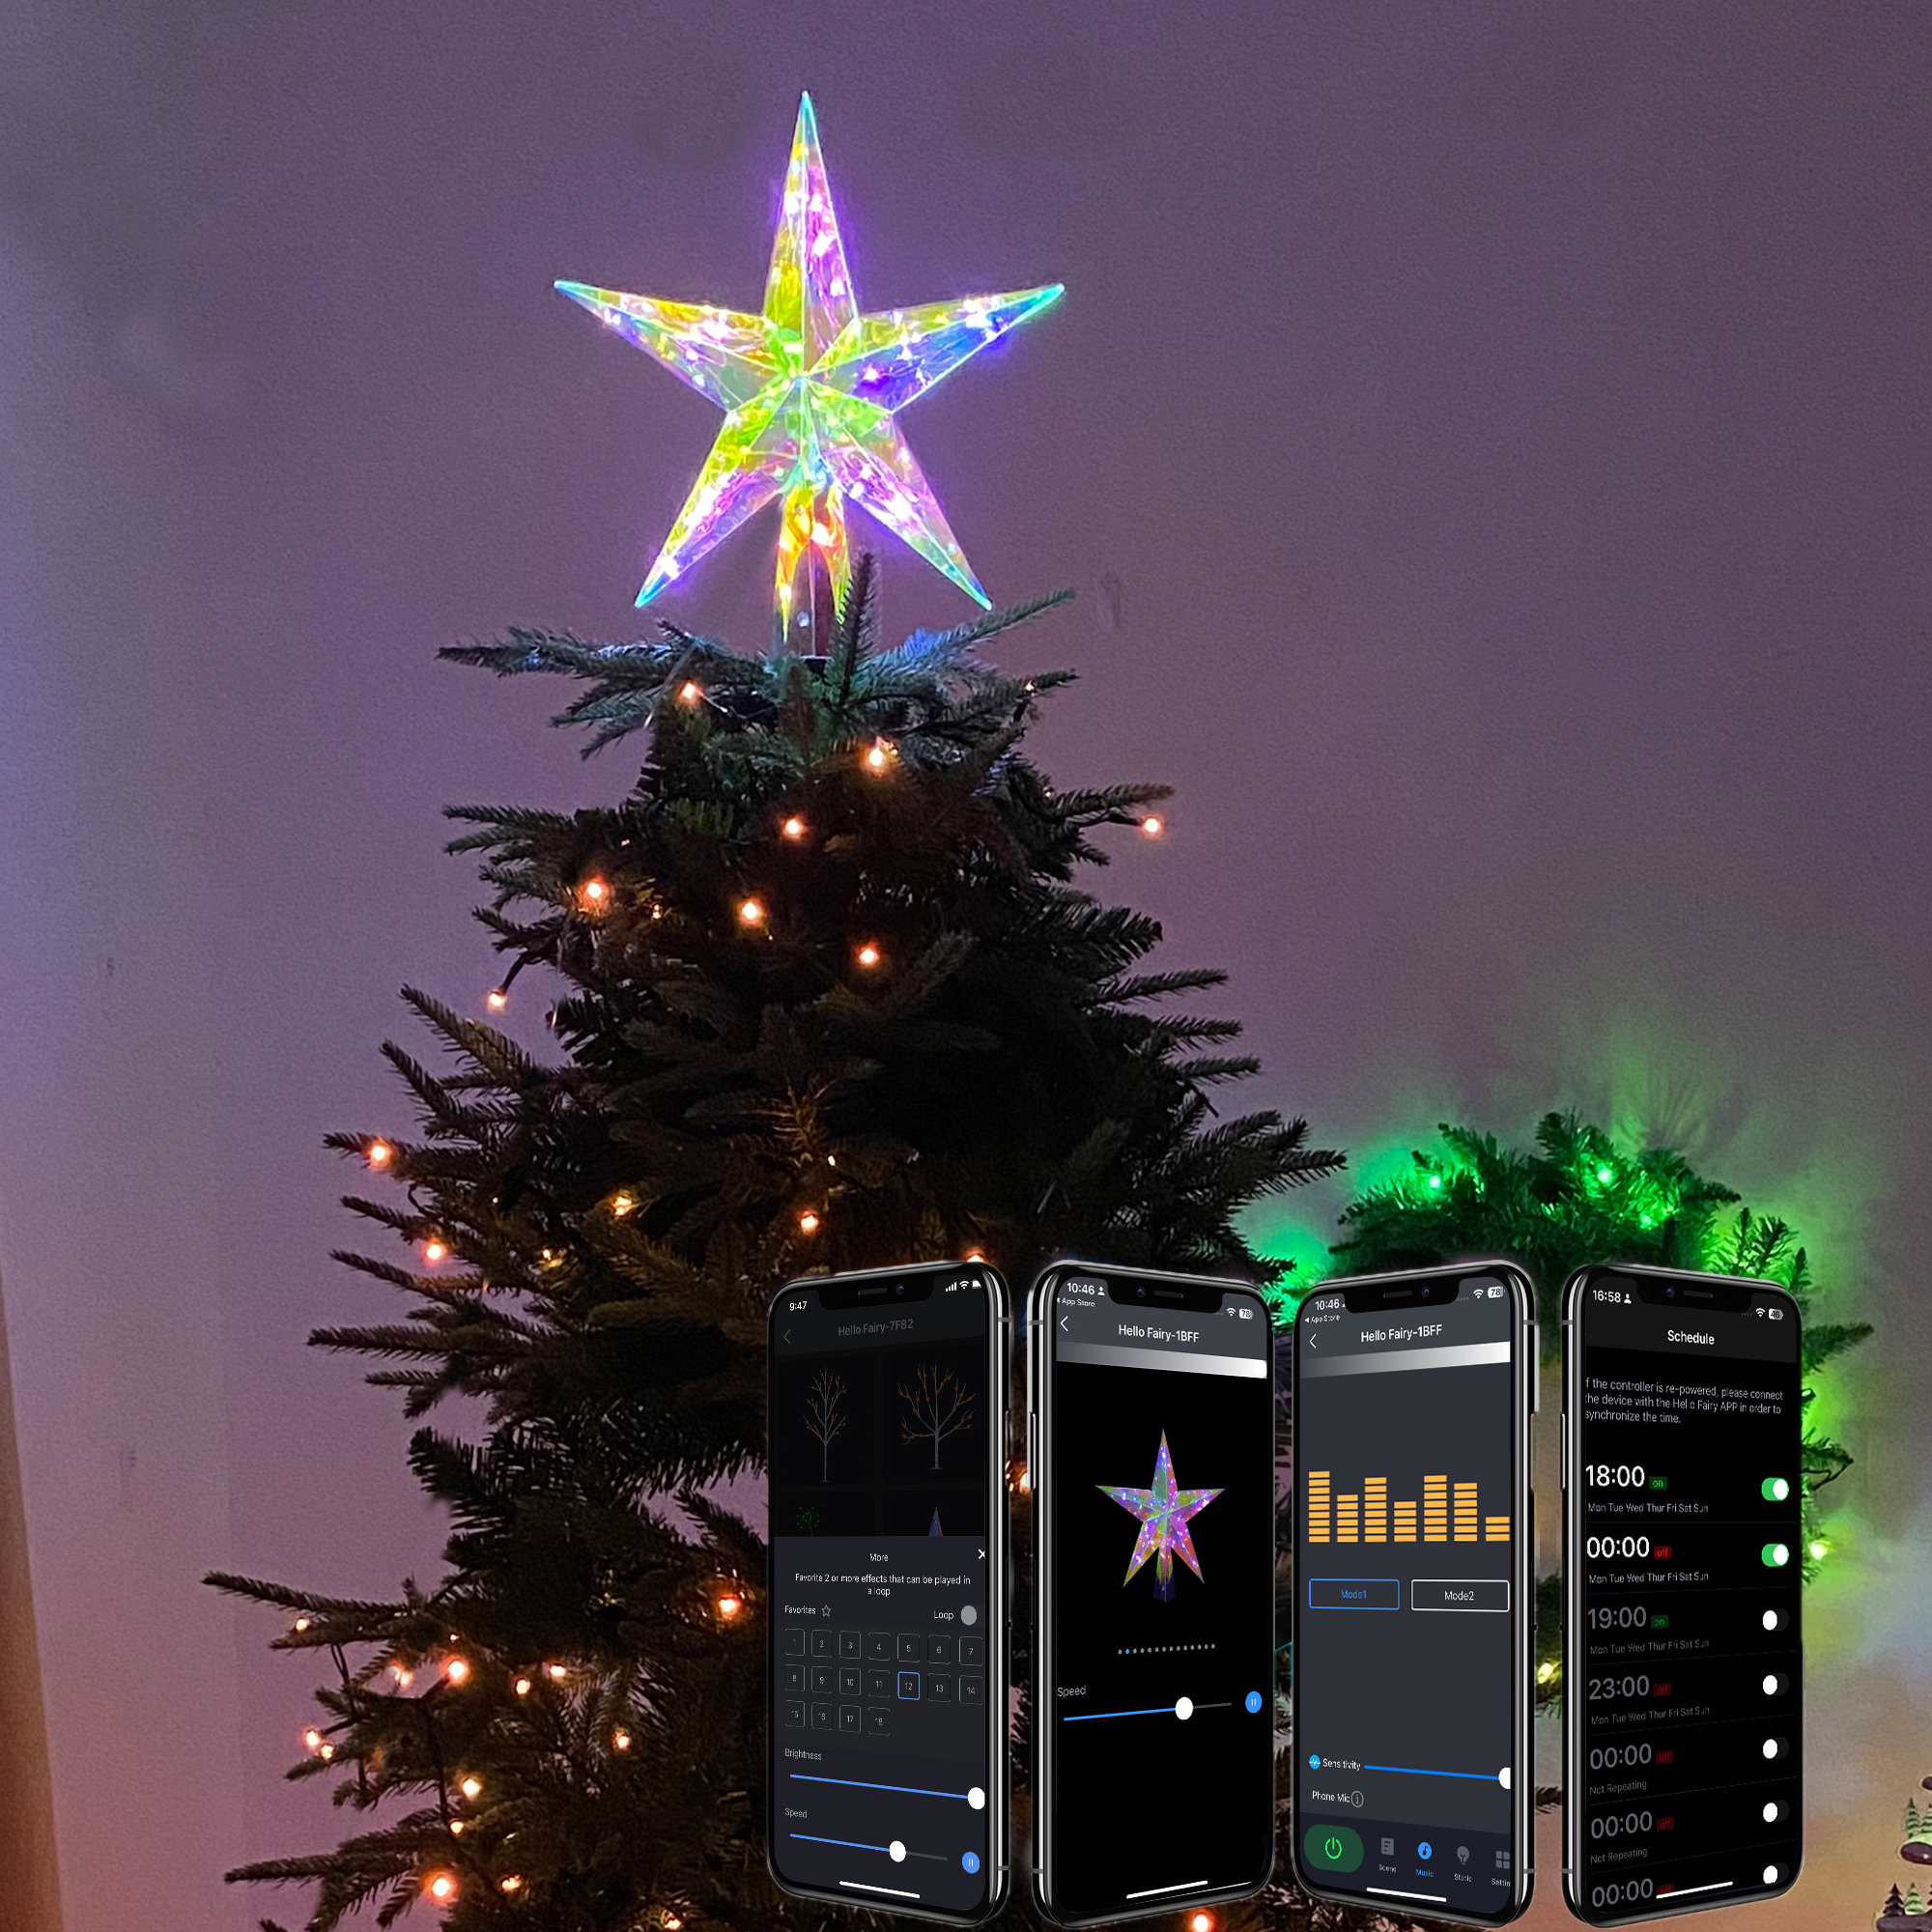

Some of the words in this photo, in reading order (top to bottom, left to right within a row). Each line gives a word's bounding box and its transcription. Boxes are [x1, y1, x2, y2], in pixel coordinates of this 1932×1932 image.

[1066, 1283, 1095, 1295] 10:46
[1062, 1297, 1075, 1307] App
[1592, 1290, 1622, 1302] 16:58
[789, 1300, 808, 1311] 9:47
[1315, 1300, 1340, 1311] 10:46
[838, 1324, 861, 1336] Hello
[1119, 1324, 1145, 1337] Hello
[1148, 1327, 1199, 1343] Fairy-1BFF
[1360, 1329, 1386, 1342] Hello
[1388, 1324, 1443, 1340] Fairy-1BFF
[1667, 1330, 1715, 1346] Schedule
[1592, 1378, 1608, 1389] the
[1610, 1380, 1654, 1393] controller
[1656, 1382, 1663, 1393] is
[1665, 1384, 1719, 1397] re-powered,
[1721, 1387, 1748, 1399] please
[1750, 1389, 1783, 1400] connect
[1602, 1395, 1634, 1406] device
[1634, 1396, 1655, 1407] with
[1656, 1397, 1670, 1408] the
[1672, 1398, 1695, 1409] Helo
[1697, 1400, 1719, 1412] Fairy
[1720, 1401, 1738, 1412] APP
[1740, 1403, 1747, 1412] in
[1748, 1403, 1772, 1414] order
[1774, 1405, 1781, 1414] to
[1585, 1409, 1640, 1422] synchronize
[1643, 1411, 1657, 1422] the
[1660, 1412, 1681, 1424] time.
[1586, 1465, 1645, 1488] 18:00
[1653, 1479, 1663, 1488] on
[1588, 1503, 1606, 1512] Mon
[1608, 1503, 1624, 1512] Tue
[1626, 1503, 1644, 1513] Wed
[1646, 1503, 1664, 1513] Thur
[1666, 1503, 1677, 1513] Fri
[1678, 1504, 1692, 1513] Sat
[1586, 1536, 1650, 1559] 00:00
[869, 1552, 889, 1562] More
[795, 1574, 823, 1583] Favorite
[861, 1575, 887, 1584] effects
[889, 1575, 904, 1584] that
[923, 1576, 933, 1585] be
[935, 1575, 961, 1586] played
[963, 1576, 971, 1584] in
[1589, 1575, 1607, 1583] Mon
[1609, 1574, 1625, 1583] Tue
[1627, 1574, 1645, 1582] Wed
[1647, 1573, 1665, 1582] Thur
[1667, 1573, 1678, 1581] Fri
[1679, 1573, 1693, 1581] Sat
[874, 1587, 891, 1597] loop
[1341, 1589, 1367, 1600] Mode1
[1444, 1590, 1474, 1602] Mode2
[784, 1605, 816, 1615] Favorites
[933, 1610, 954, 1621] Loop
[1588, 1606, 1647, 1630] 19:00
[1590, 1645, 1608, 1655] Mon
[1628, 1643, 1646, 1653] Wed
[1648, 1642, 1666, 1652] Thur
[1667, 1640, 1678, 1650] Fri
[1679, 1640, 1693, 1650] Sat
[1057, 1684, 1087, 1698] Speed
[1589, 1675, 1649, 1700] 23:00
[1591, 1716, 1609, 1725] Mon
[1611, 1714, 1627, 1723] Tue
[1629, 1712, 1646, 1722] Wed
[1648, 1711, 1667, 1720] Thur
[1668, 1709, 1679, 1719] Fri
[1680, 1708, 1694, 1718] Sat
[784, 1748, 822, 1761] Brightness
[1590, 1743, 1652, 1771] 00:00
[1322, 1758, 1361, 1772] Sensitivity
[1589, 1785, 1605, 1796] Not
[1606, 1779, 1647, 1794] Repeating
[1311, 1791, 1335, 1803] Phone
[1337, 1792, 1350, 1803] Mic
[784, 1807, 808, 1818] Speed
[1591, 1811, 1652, 1839] 00:00
[1590, 1854, 1606, 1864] Not
[1607, 1848, 1648, 1861] Repeating
[1415, 1868, 1435, 1878] Music
[1592, 1878, 1653, 1908] 00:00
